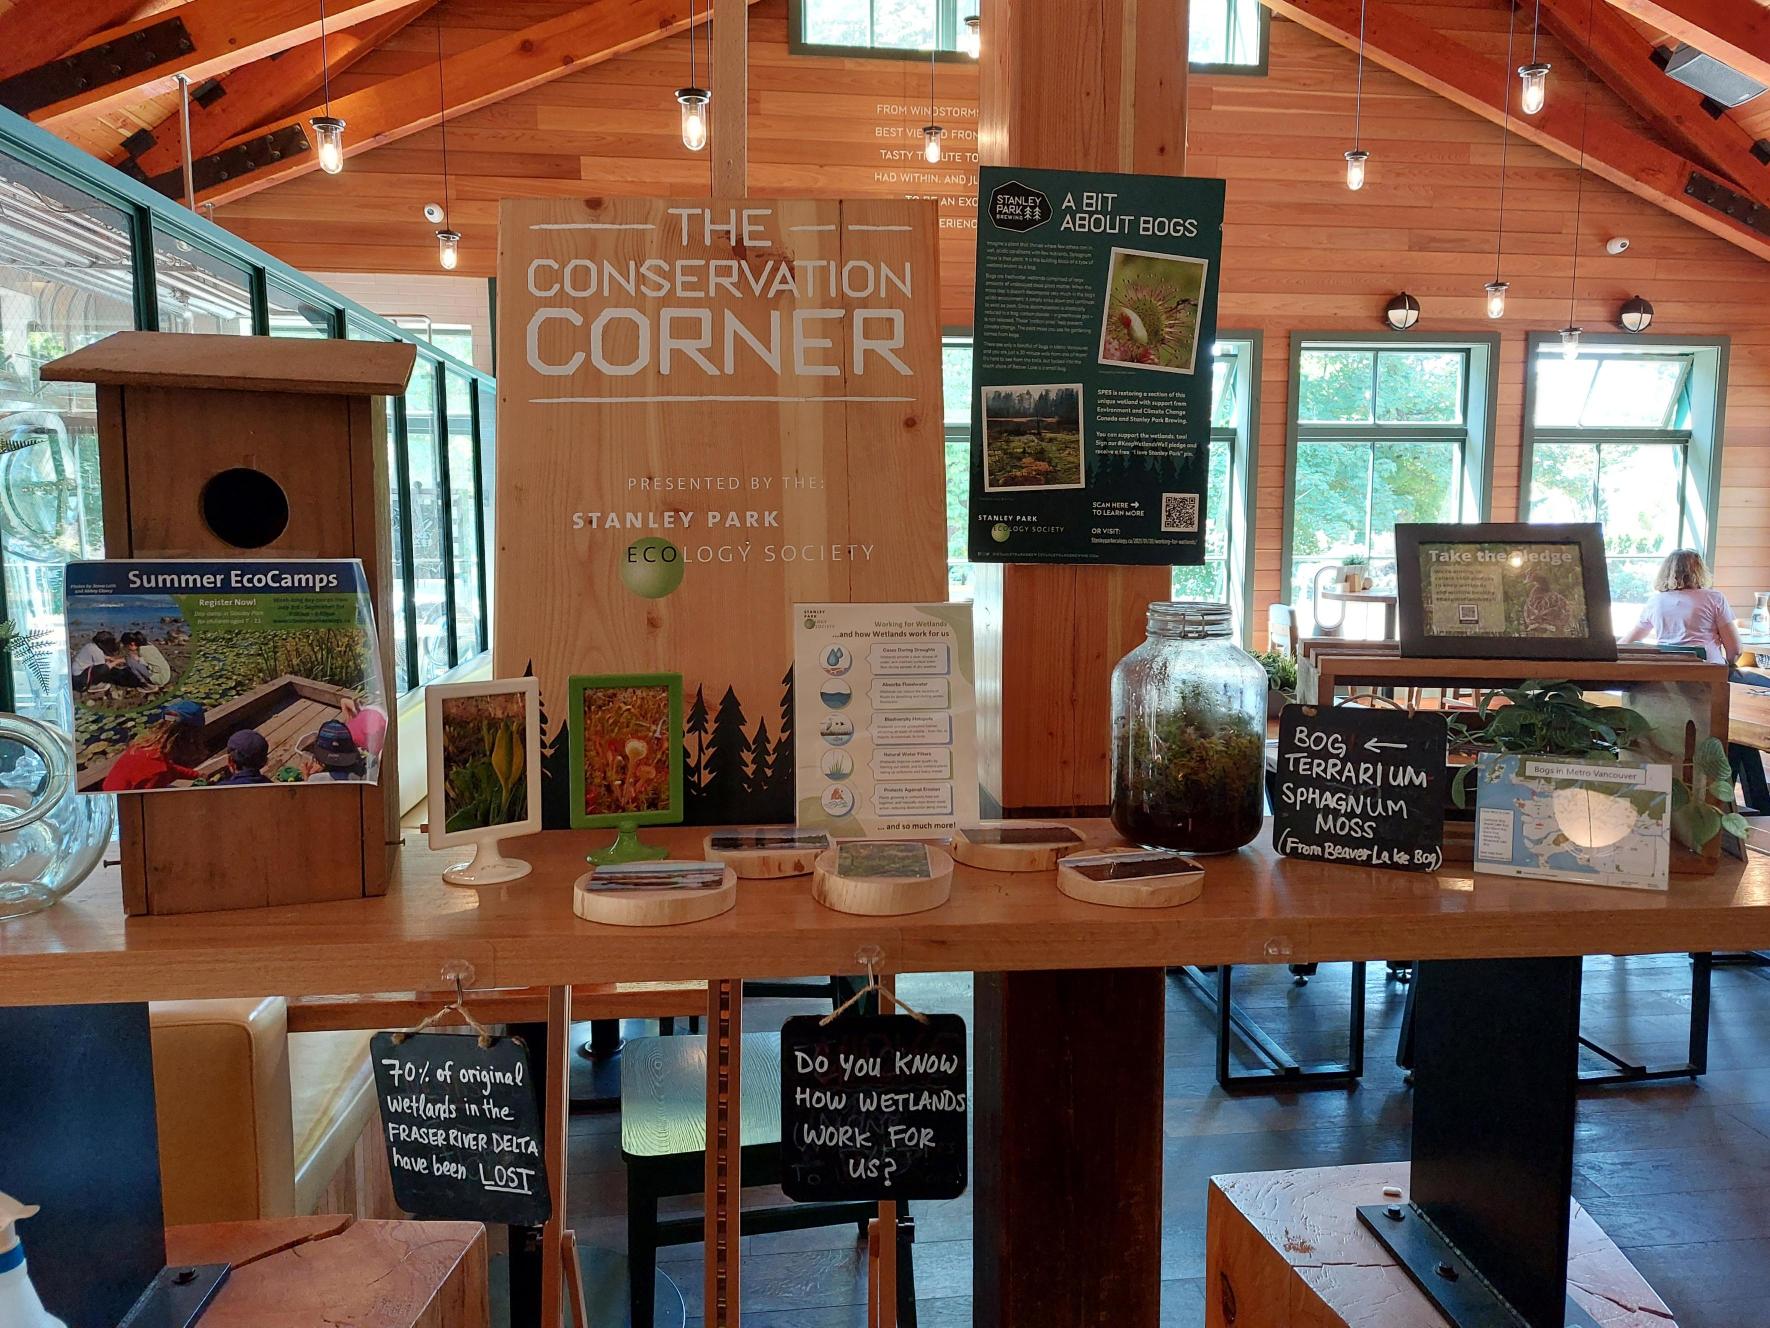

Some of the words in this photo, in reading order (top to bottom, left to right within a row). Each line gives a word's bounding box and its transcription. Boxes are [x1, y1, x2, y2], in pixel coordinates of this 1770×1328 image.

[877, 104, 906, 114] FROM
[876, 127, 903, 136] BEST
[880, 150, 913, 160] TASTY
[874, 172, 896, 182] HAD
[944, 175, 966, 184] AND
[941, 197, 954, 206] AN
[996, 205, 1022, 215] PARK
[997, 195, 1041, 205] STANLEY
[1062, 192, 1076, 210] A
[1083, 192, 1117, 211] BIT
[667, 208, 772, 247] THE
[1061, 214, 1134, 234] ABOUT
[1140, 217, 1198, 237] BOGS
[527, 258, 912, 298] CONSERVATION
[526, 308, 913, 376] CORNER
[628, 478, 740, 490] PRESENTED
[751, 477, 772, 490] BY
[782, 477, 825, 489] THE:
[572, 511, 694, 528] STANLEY
[707, 511, 780, 528] PARK
[627, 546, 750, 563] ECOLOGY
[764, 544, 874, 562] SOCIETY
[1428, 550, 1472, 562] Take
[1476, 550, 1506, 562] the
[128, 570, 224, 588] Summer
[231, 570, 338, 591] EcoCamps
[199, 599, 232, 607] Register
[1294, 726, 1347, 758] BOG
[1285, 753, 1427, 788] TERRARIUM
[1534, 766, 1554, 775] Bogs
[1593, 770, 1637, 780] Vancouver
[1282, 783, 1408, 819] SPHAGNUM
[1316, 814, 1376, 838] MOSS
[1278, 828, 1322, 856] (From
[1324, 843, 1372, 860] Beaver
[1372, 845, 1409, 864] Lake
[1414, 846, 1442, 872] Bog)
[895, 1051, 958, 1074] KNOW
[381, 1059, 430, 1086] 70%
[437, 1061, 453, 1081] of
[460, 1061, 523, 1095] original
[464, 1098, 479, 1116] in
[483, 1099, 514, 1120] the
[795, 1087, 846, 1110] HOW
[860, 1090, 966, 1112] WETLANDS
[389, 1122, 447, 1145] FRASER
[449, 1130, 487, 1150] RIVER
[492, 1133, 538, 1156] DELTA
[803, 1124, 871, 1148] WORK
[888, 1125, 935, 1148] FOR
[392, 1147, 428, 1174] have
[433, 1155, 466, 1180] been
[479, 1163, 535, 1191] LOST
